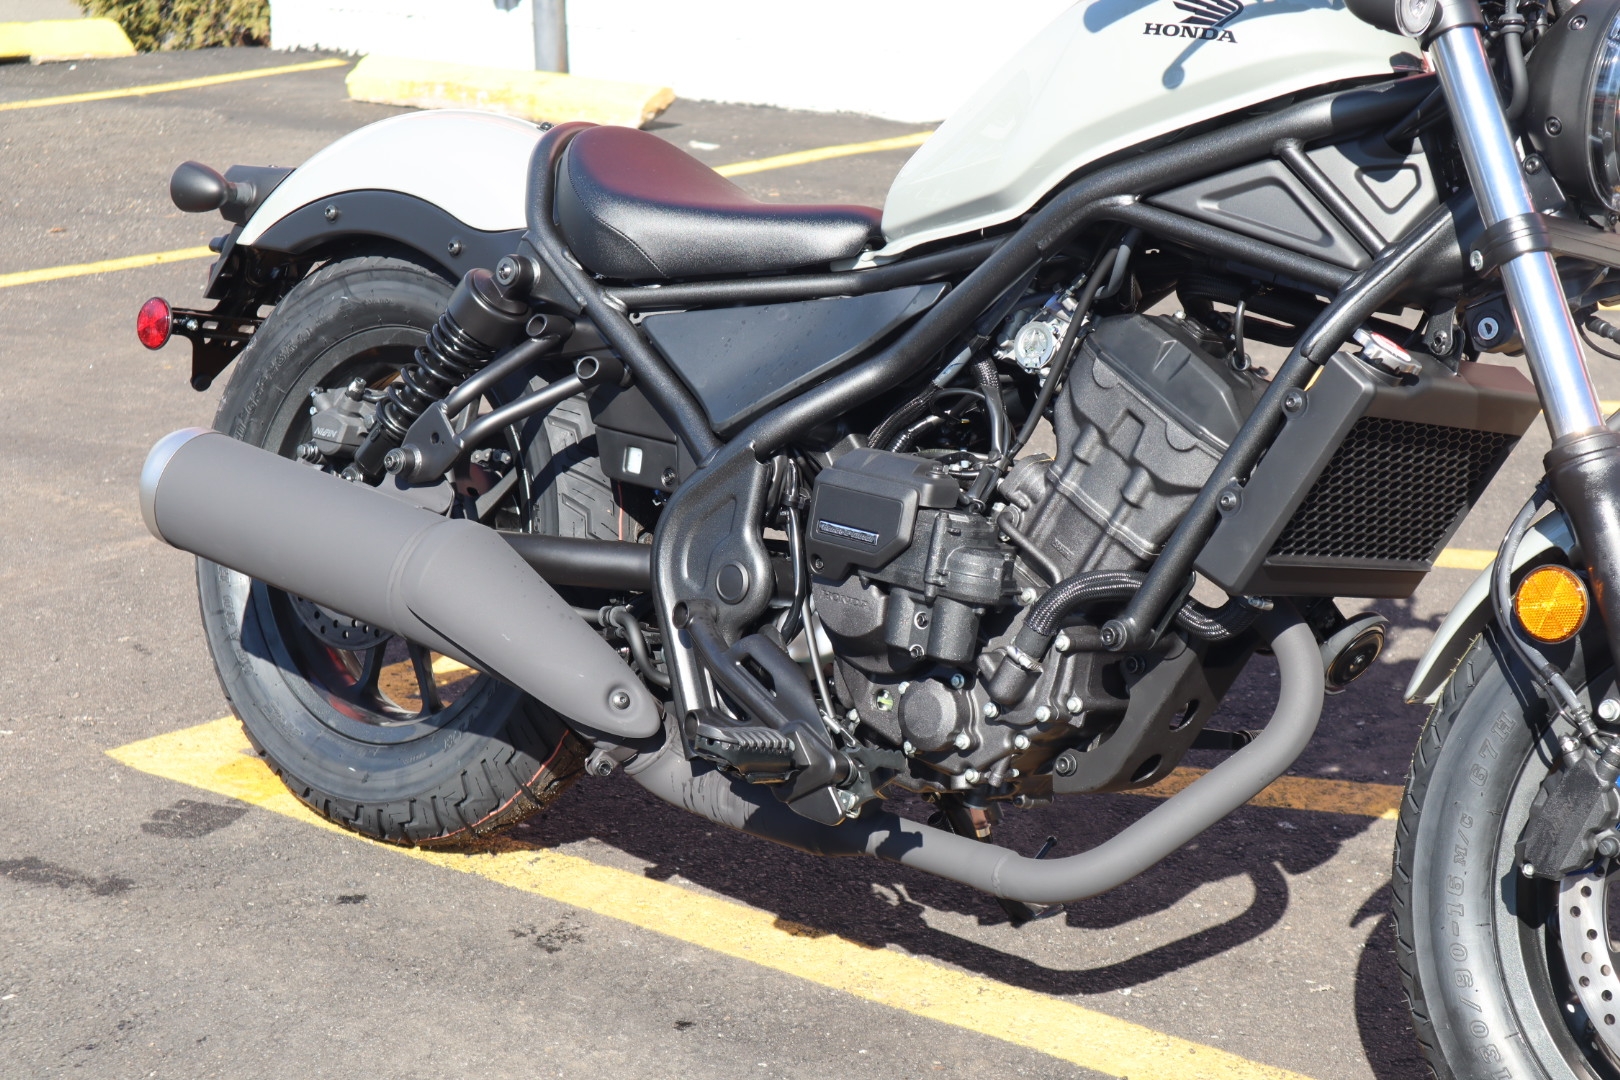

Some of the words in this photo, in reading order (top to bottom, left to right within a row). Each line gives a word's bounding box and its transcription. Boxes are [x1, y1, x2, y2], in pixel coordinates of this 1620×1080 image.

[1143, 23, 1238, 43] HONDA
[1453, 812, 1474, 866] M/C
[1469, 711, 1516, 788] 67H
